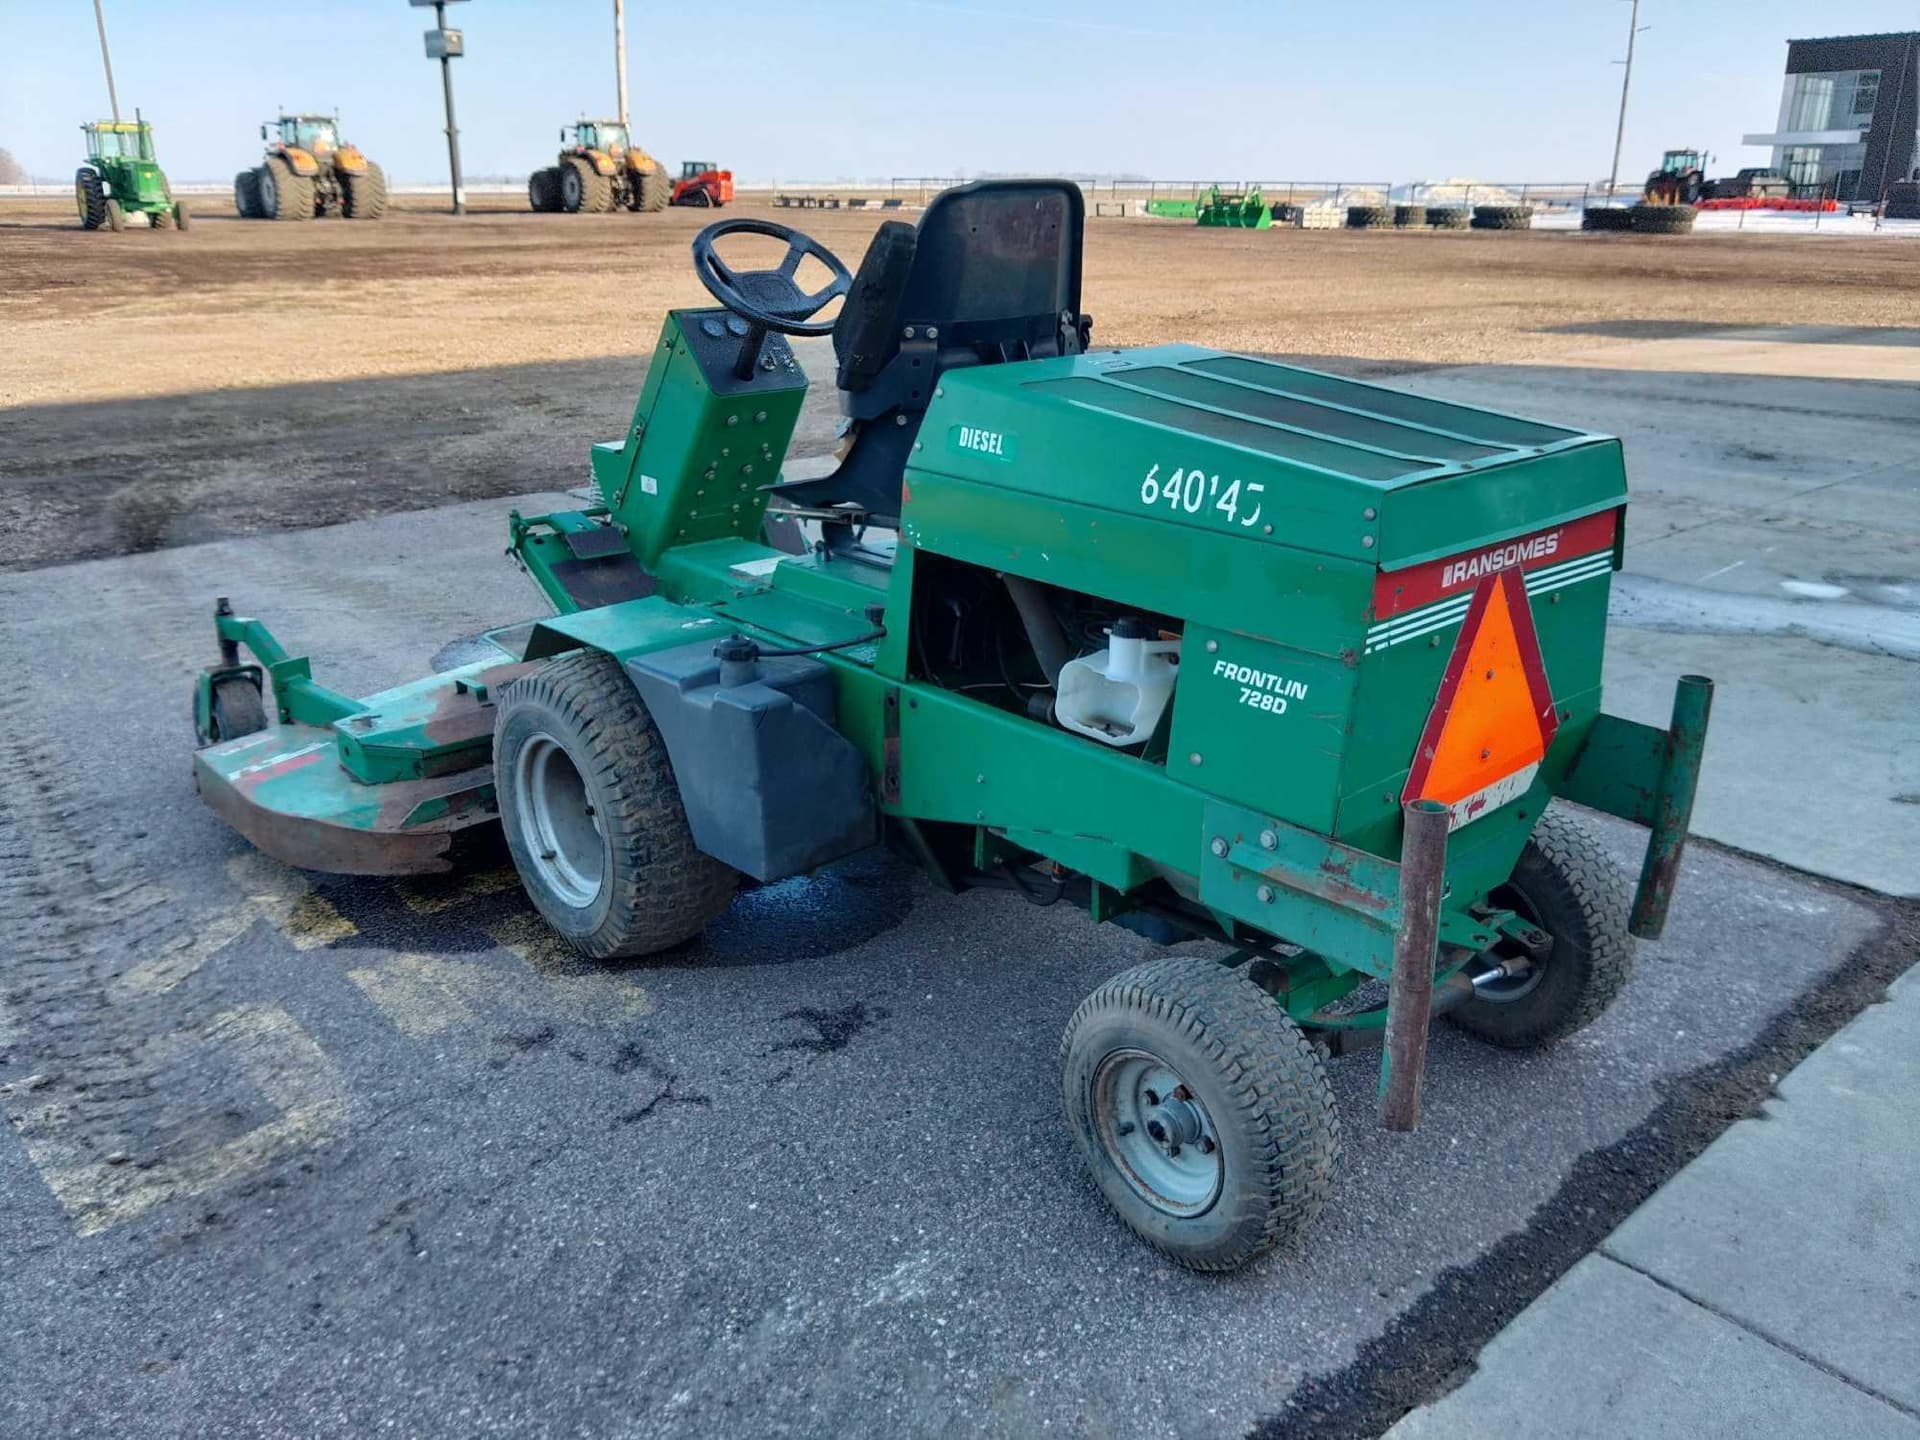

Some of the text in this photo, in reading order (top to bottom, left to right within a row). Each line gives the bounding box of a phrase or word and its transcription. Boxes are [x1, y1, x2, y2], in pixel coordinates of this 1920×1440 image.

[959, 427, 1003, 455] DIESEL
[1451, 532, 1558, 583] RANSOMES
[1213, 660, 1308, 704] FRONTLIN
[1239, 687, 1288, 715] 728D
